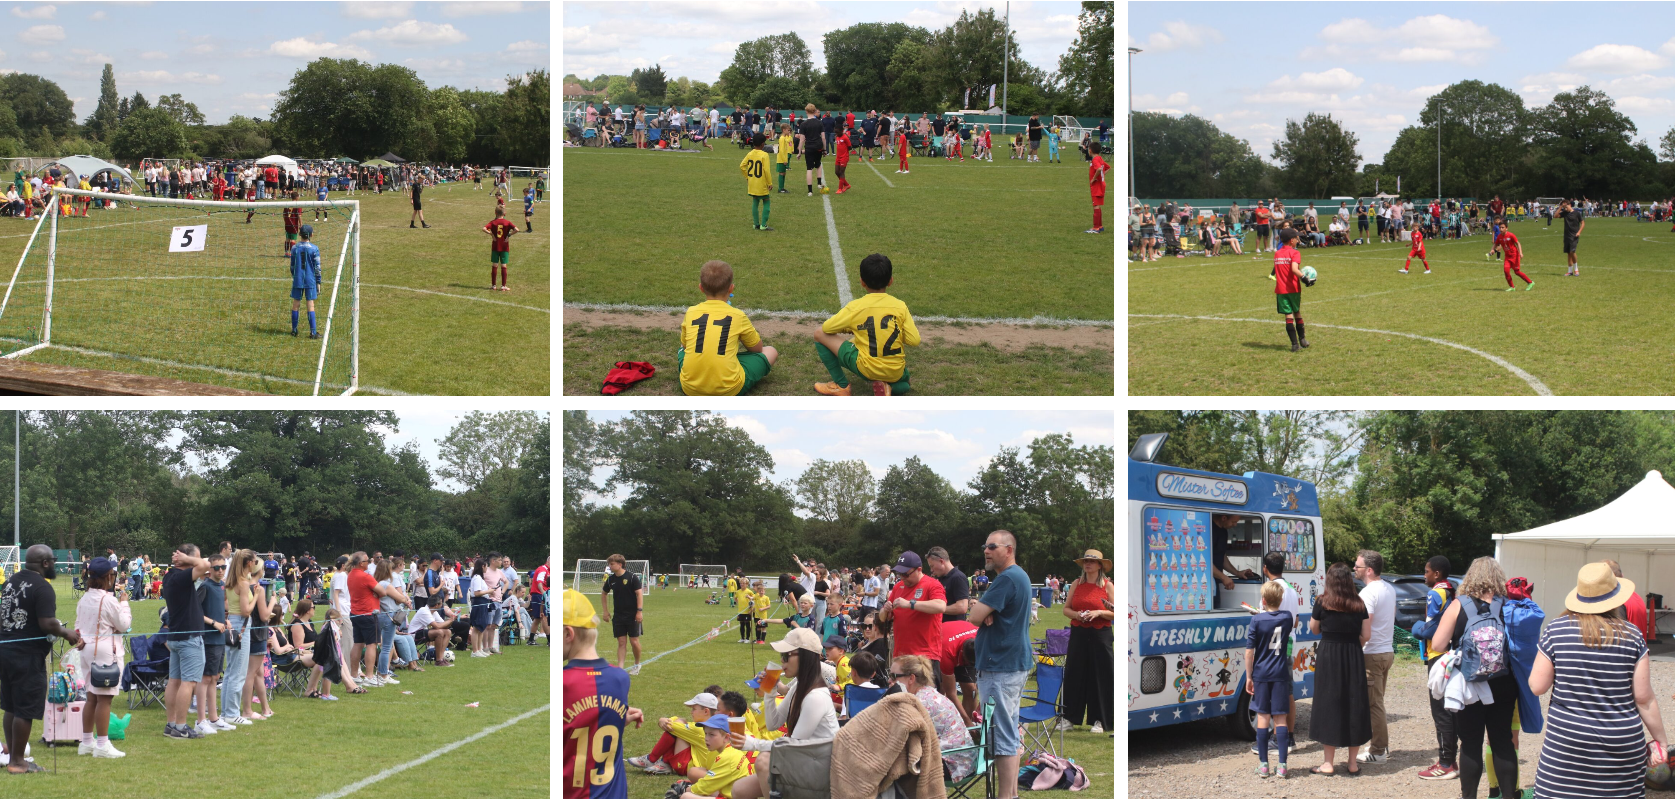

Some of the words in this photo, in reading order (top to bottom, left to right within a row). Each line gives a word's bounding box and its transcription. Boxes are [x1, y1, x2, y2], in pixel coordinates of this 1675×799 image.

[747, 159, 763, 178] 20
[180, 229, 195, 247] 5
[497, 224, 504, 238] 5
[691, 313, 733, 356] 11
[856, 315, 902, 357] 12
[1162, 474, 1209, 495] Mister
[1211, 481, 1244, 501] Softee
[1150, 624, 1212, 647] FRESHLY
[1268, 626, 1282, 656] 4
[563, 695, 599, 723] LAMINE
[600, 695, 628, 719] YAMAL
[570, 724, 620, 788] 19
